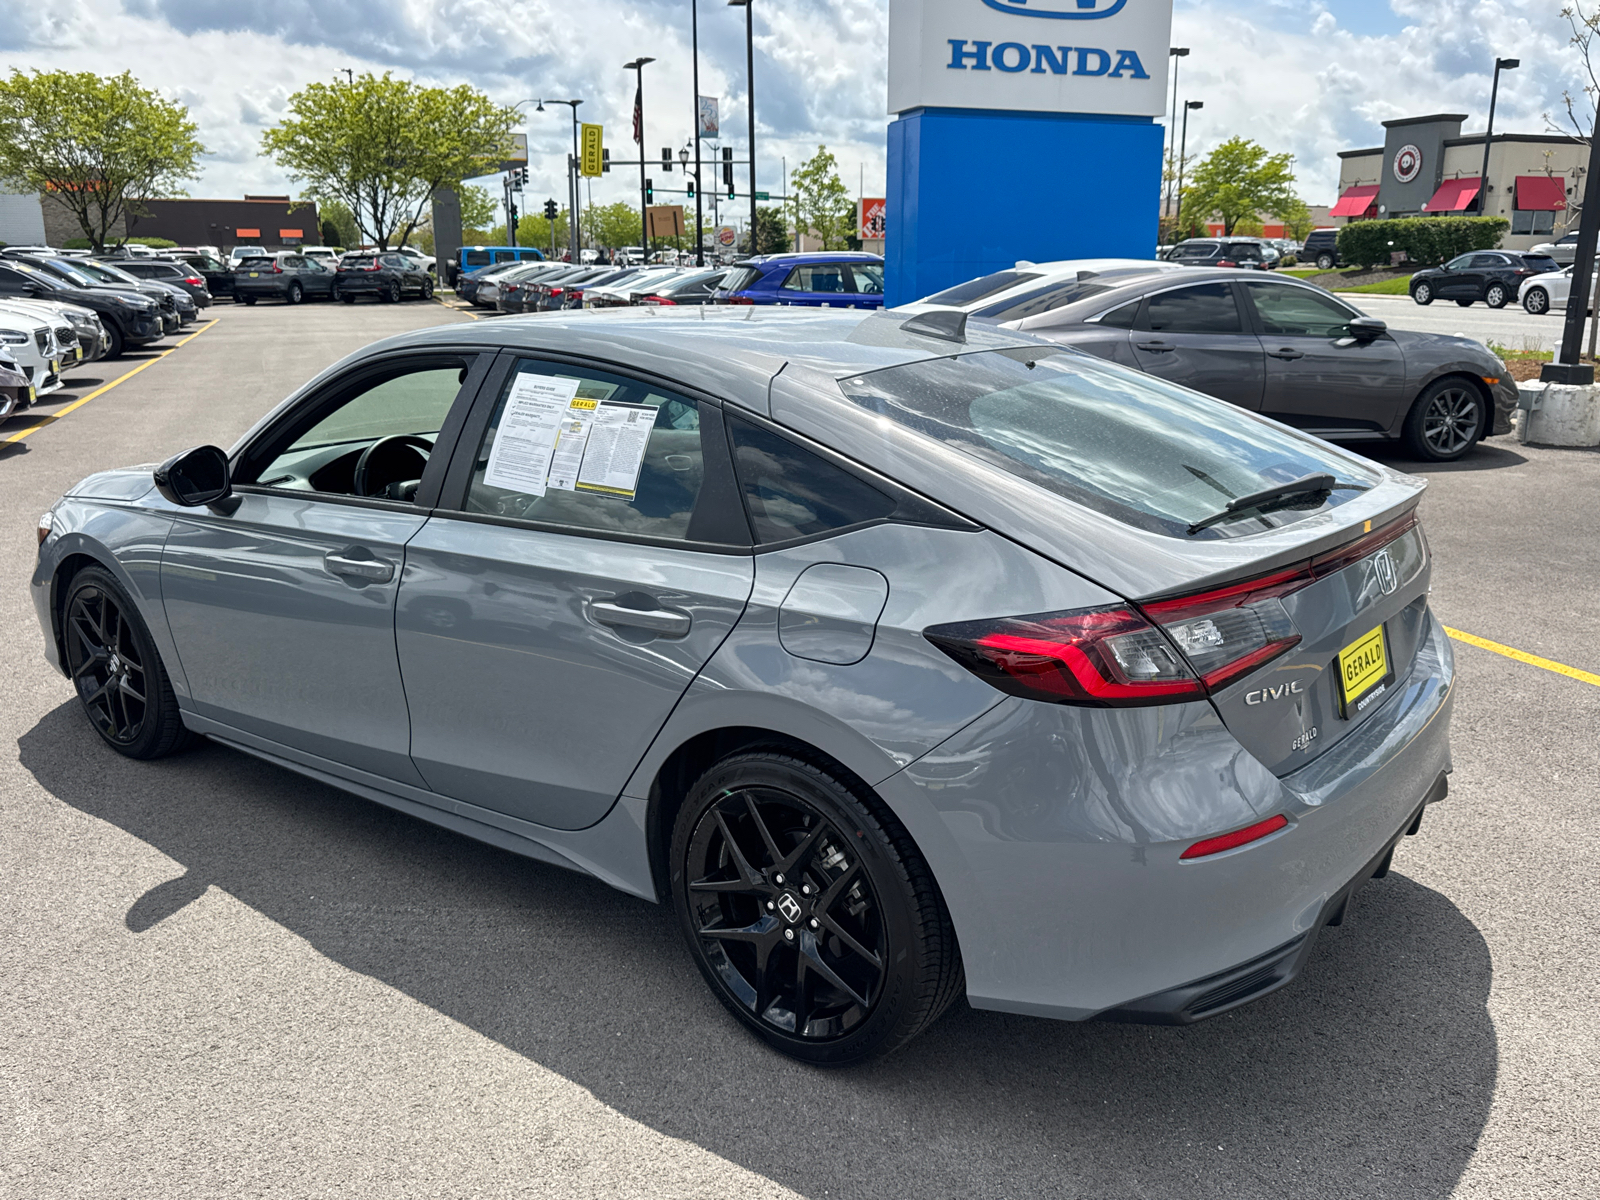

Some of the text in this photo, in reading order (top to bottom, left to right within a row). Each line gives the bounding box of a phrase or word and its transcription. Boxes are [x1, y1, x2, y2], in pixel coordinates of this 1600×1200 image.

[947, 39, 1150, 79] HONDA
[588, 130, 596, 171] GERALD
[865, 202, 881, 219] THE
[572, 400, 596, 408] GERALD
[1346, 643, 1381, 681] GERALD
[1245, 678, 1304, 706] CIVIC
[1357, 684, 1385, 710] COUNTRYSIDE
[1292, 726, 1318, 751] GERALD
